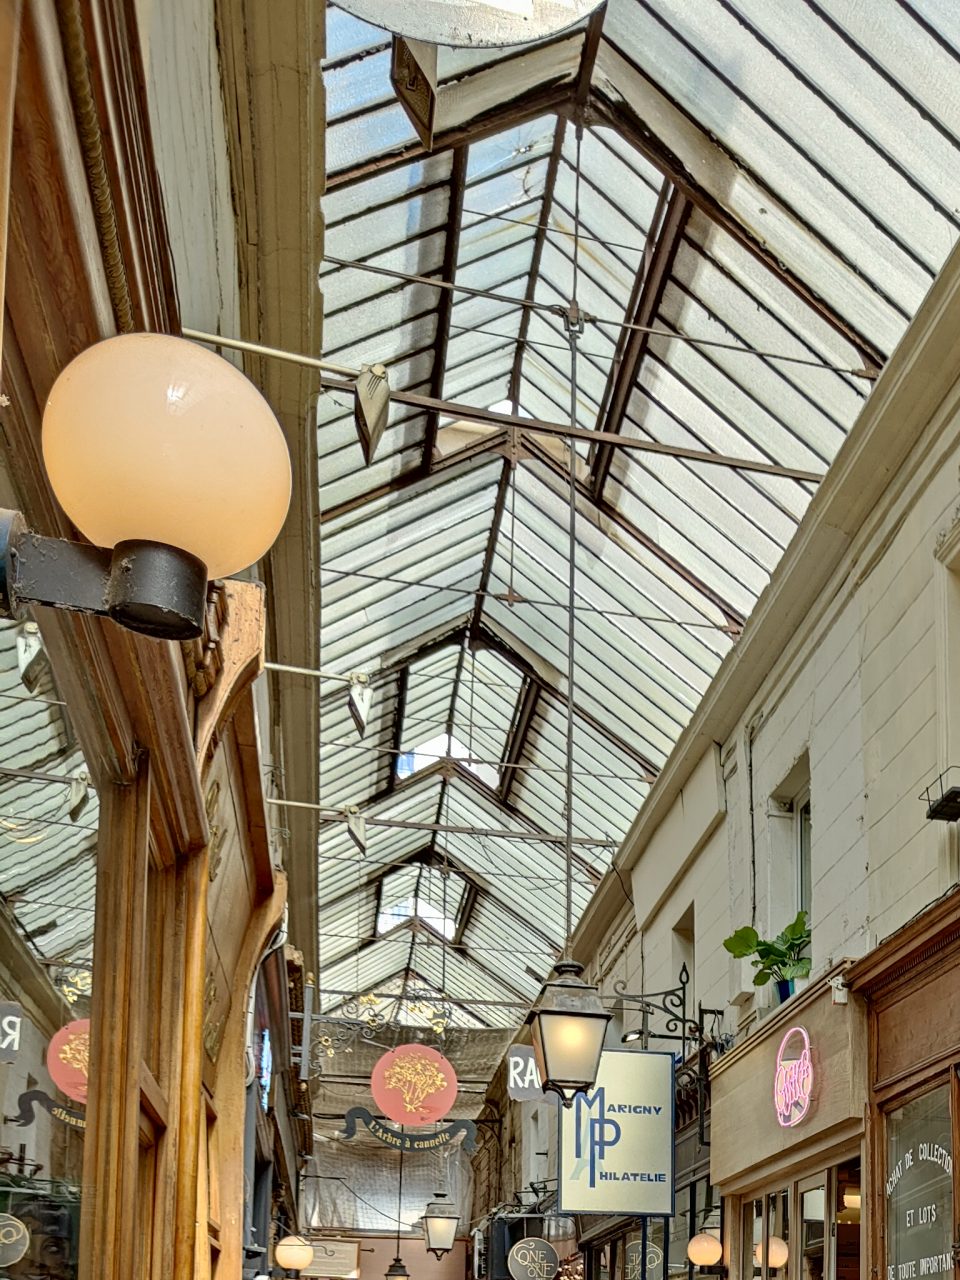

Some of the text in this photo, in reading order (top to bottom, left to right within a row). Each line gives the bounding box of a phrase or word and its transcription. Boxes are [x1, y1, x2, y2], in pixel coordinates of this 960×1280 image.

[369, 1121, 450, 1149] L'Arbre à cannelle
[905, 1149, 914, 1170] DE
[906, 1203, 937, 1227] ET LOTS
[514, 1246, 547, 1265] ONE
[887, 1264, 895, 1280] DE
[898, 1261, 917, 1280] TOUTE
